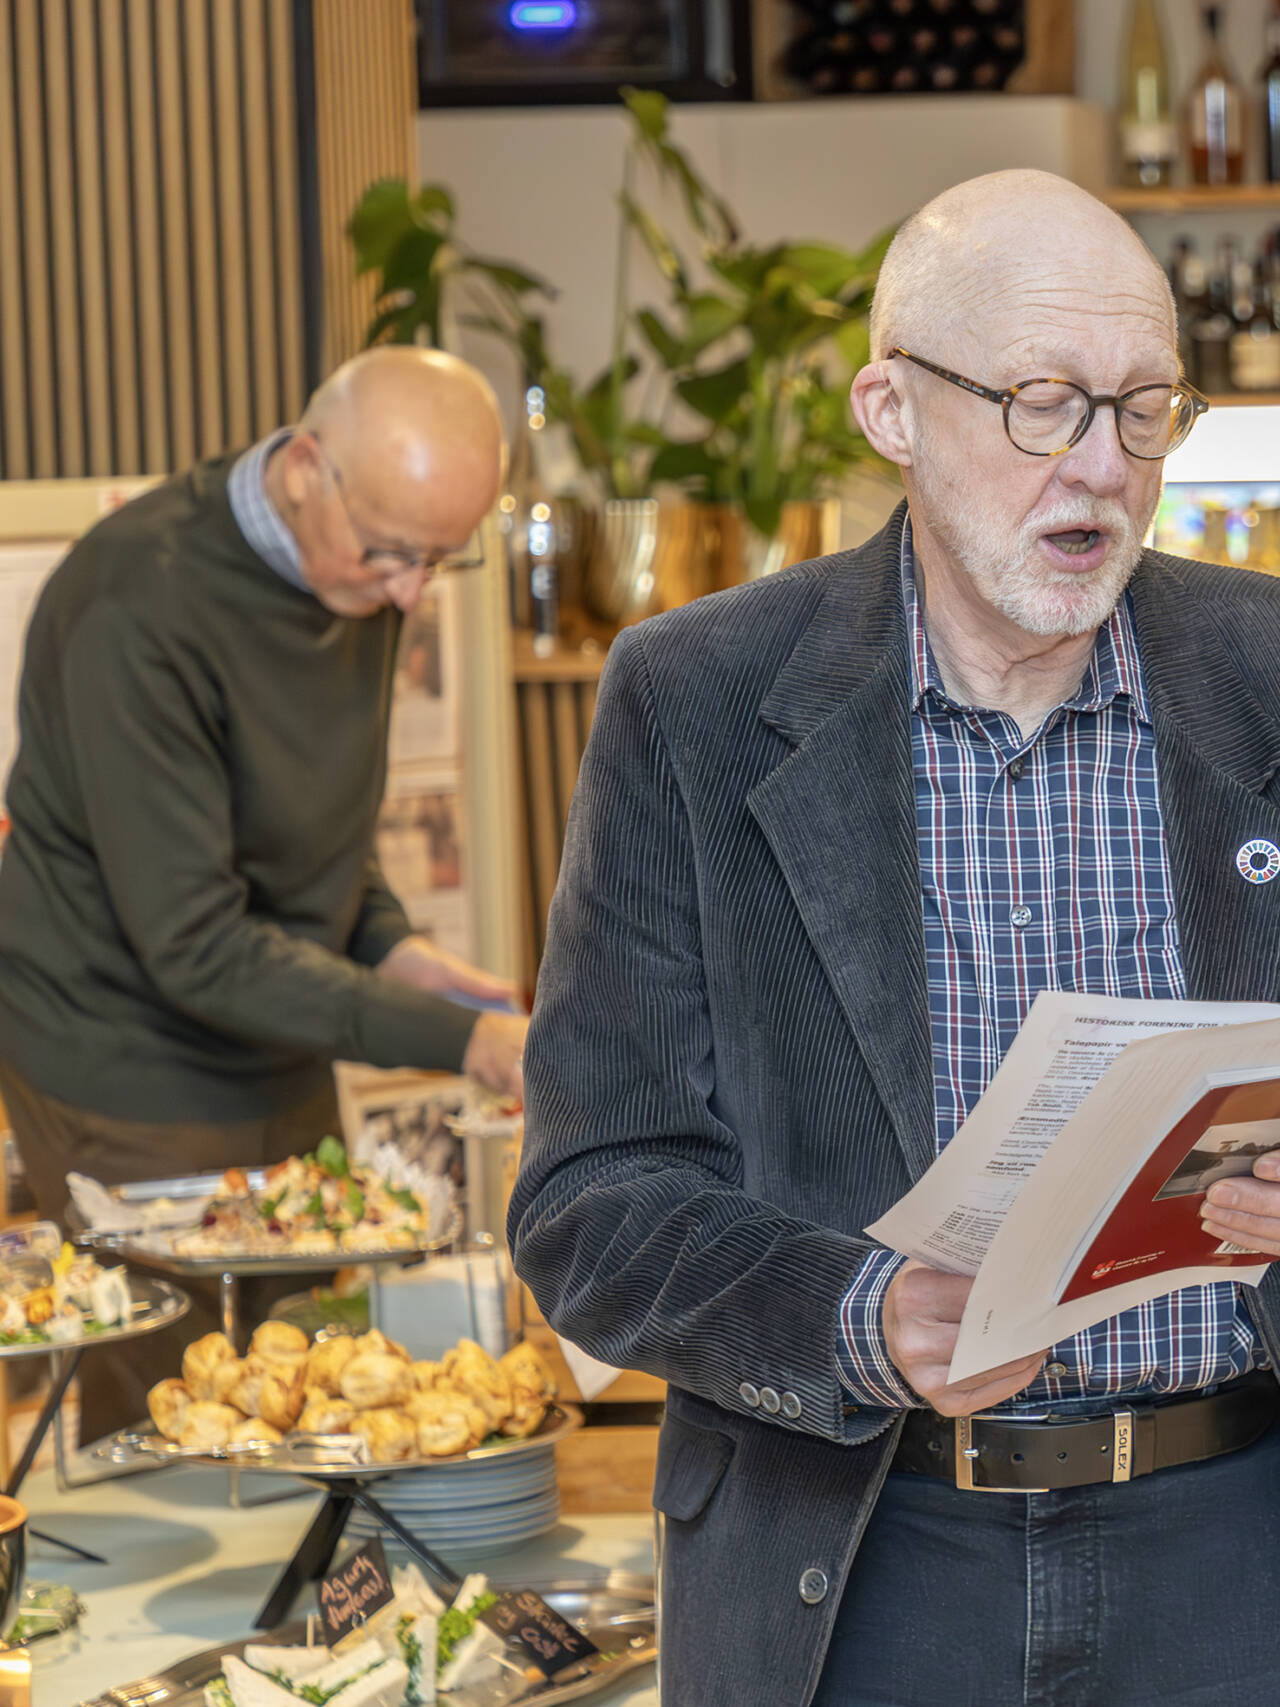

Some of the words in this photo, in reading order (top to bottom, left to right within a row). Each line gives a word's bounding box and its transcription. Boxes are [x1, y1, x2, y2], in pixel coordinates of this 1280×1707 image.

[1074, 1016, 1136, 1027] HISTORISK
[1138, 1020, 1194, 1029] FORENING
[1063, 1039, 1112, 1048] Talepapir
[1118, 1427, 1128, 1470] SOLEX
